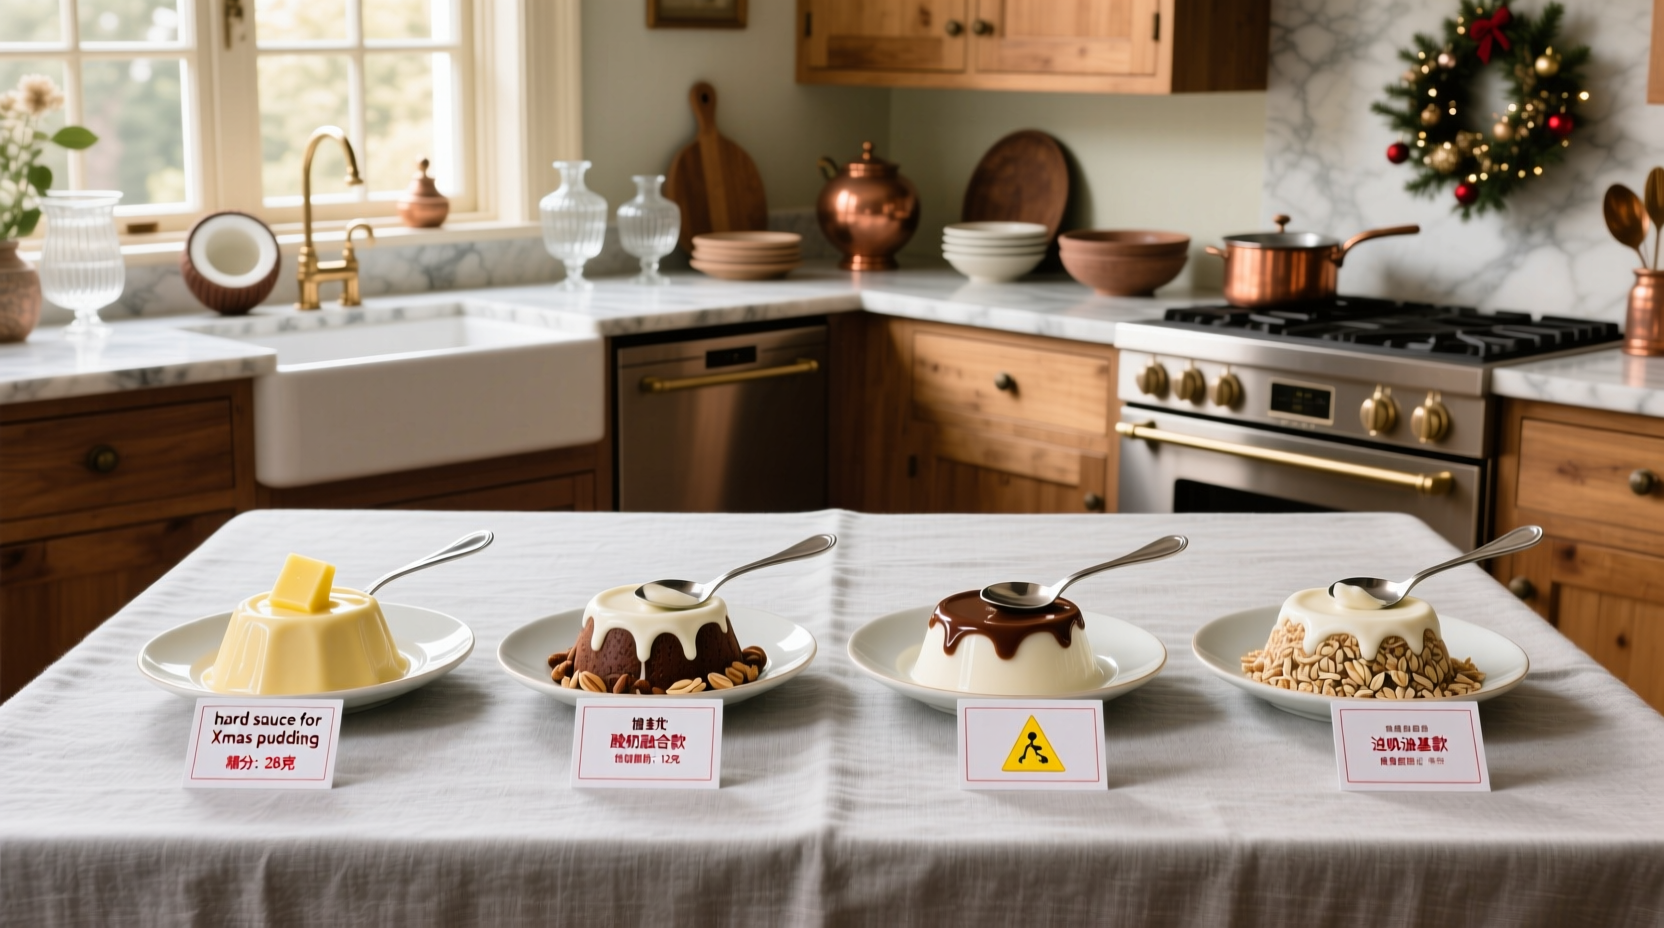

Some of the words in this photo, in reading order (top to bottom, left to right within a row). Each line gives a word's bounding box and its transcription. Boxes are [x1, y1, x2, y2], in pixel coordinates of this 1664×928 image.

[214, 711, 250, 726] hard
[253, 715, 296, 726] sauce
[300, 712, 322, 727] for
[211, 729, 253, 745] Xmas
[256, 730, 319, 749] pudding
